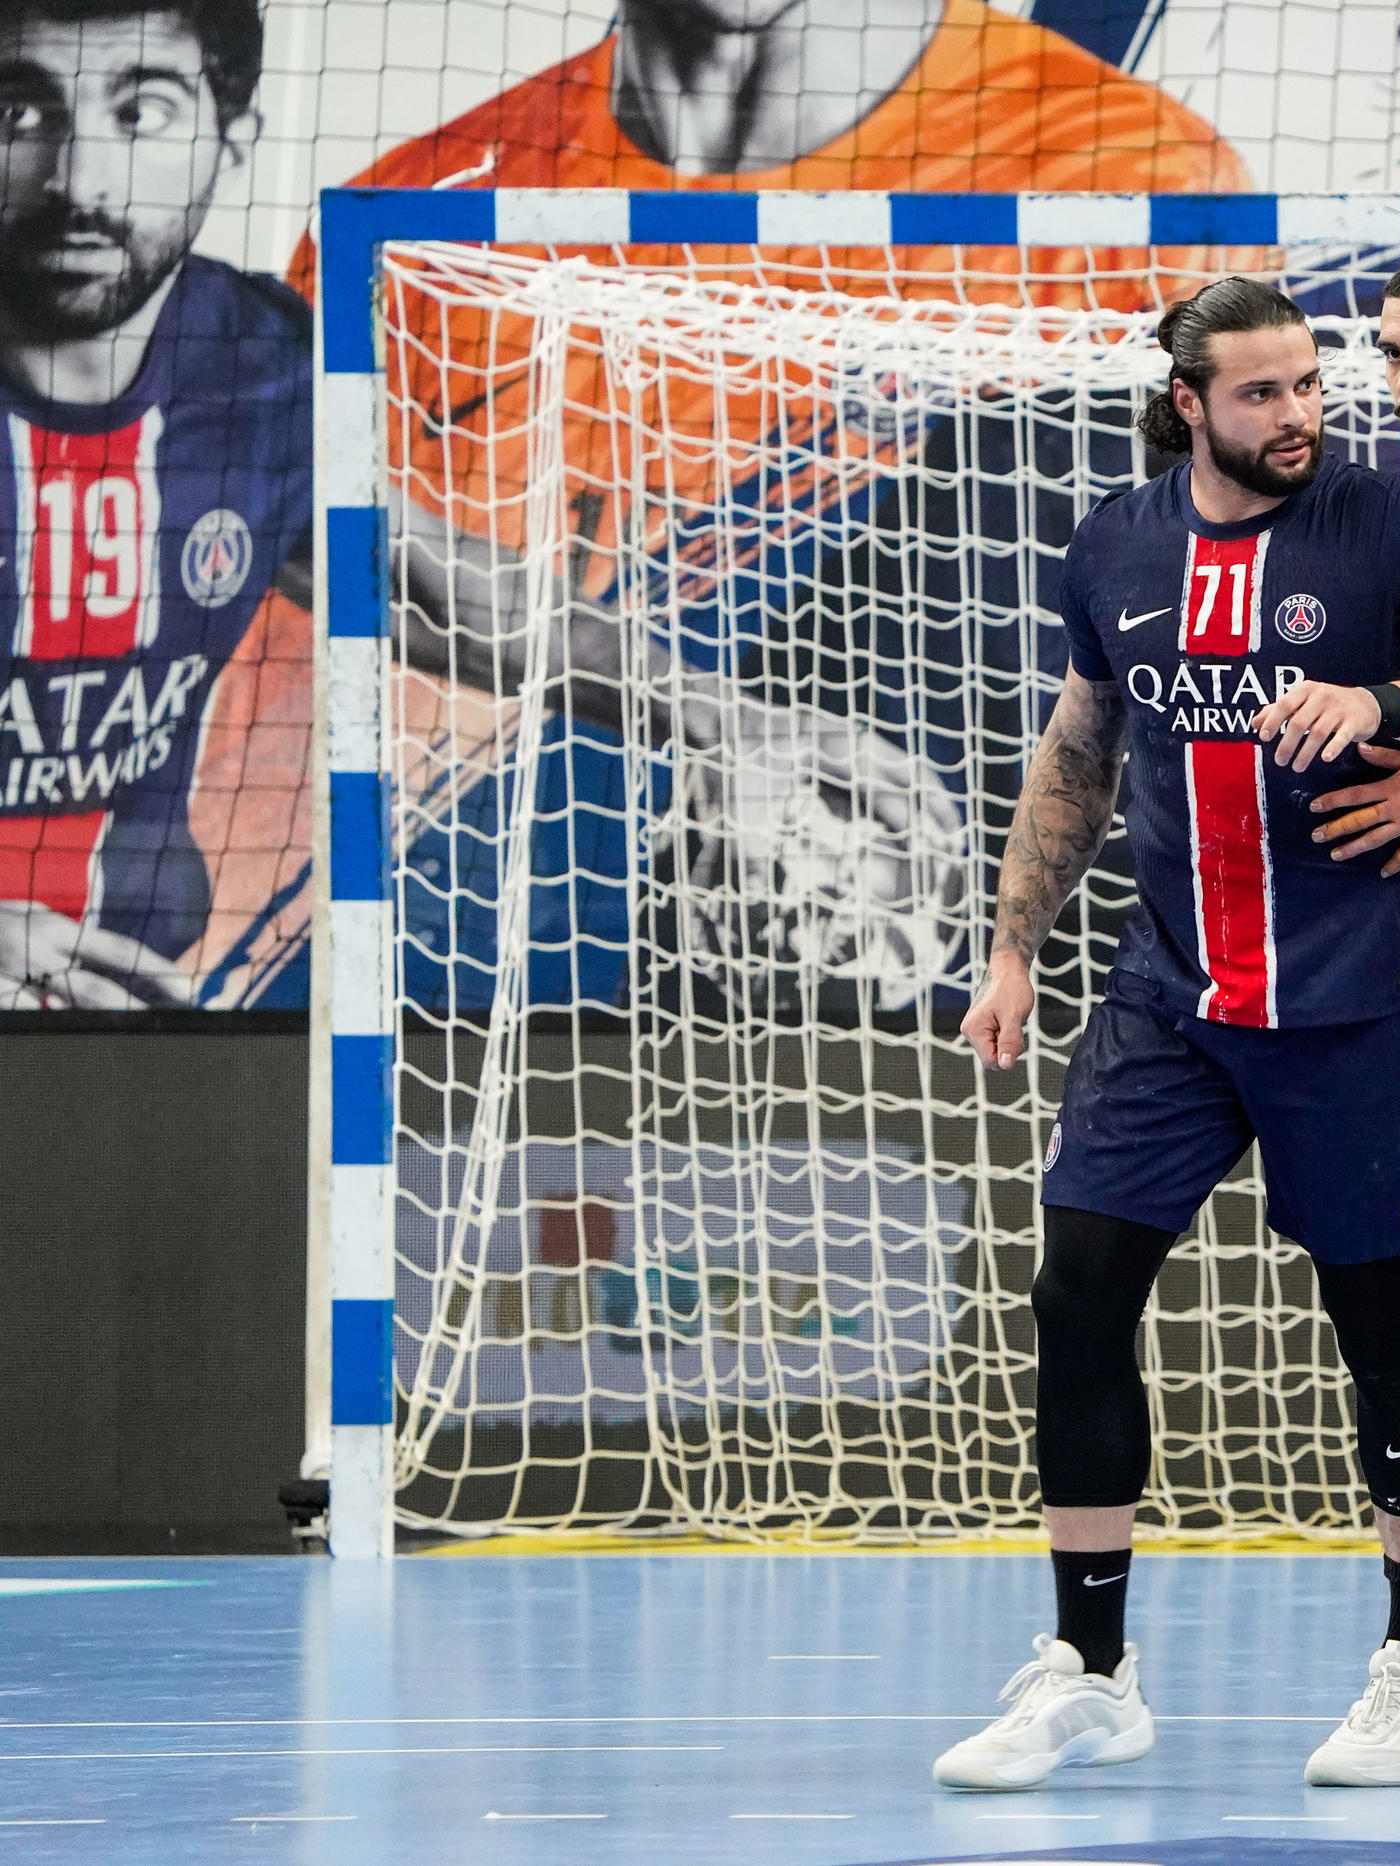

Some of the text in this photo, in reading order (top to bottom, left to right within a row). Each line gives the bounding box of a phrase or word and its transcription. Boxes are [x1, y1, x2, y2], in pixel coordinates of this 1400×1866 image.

[40, 477, 138, 622] 19
[1193, 563, 1247, 636] 71
[1283, 596, 1318, 609] PARIS
[0, 654, 208, 753] ATAR
[1127, 659, 1306, 714] QATAR
[1171, 707, 1310, 735] AIRW
[0, 722, 177, 806] IRWAYS
